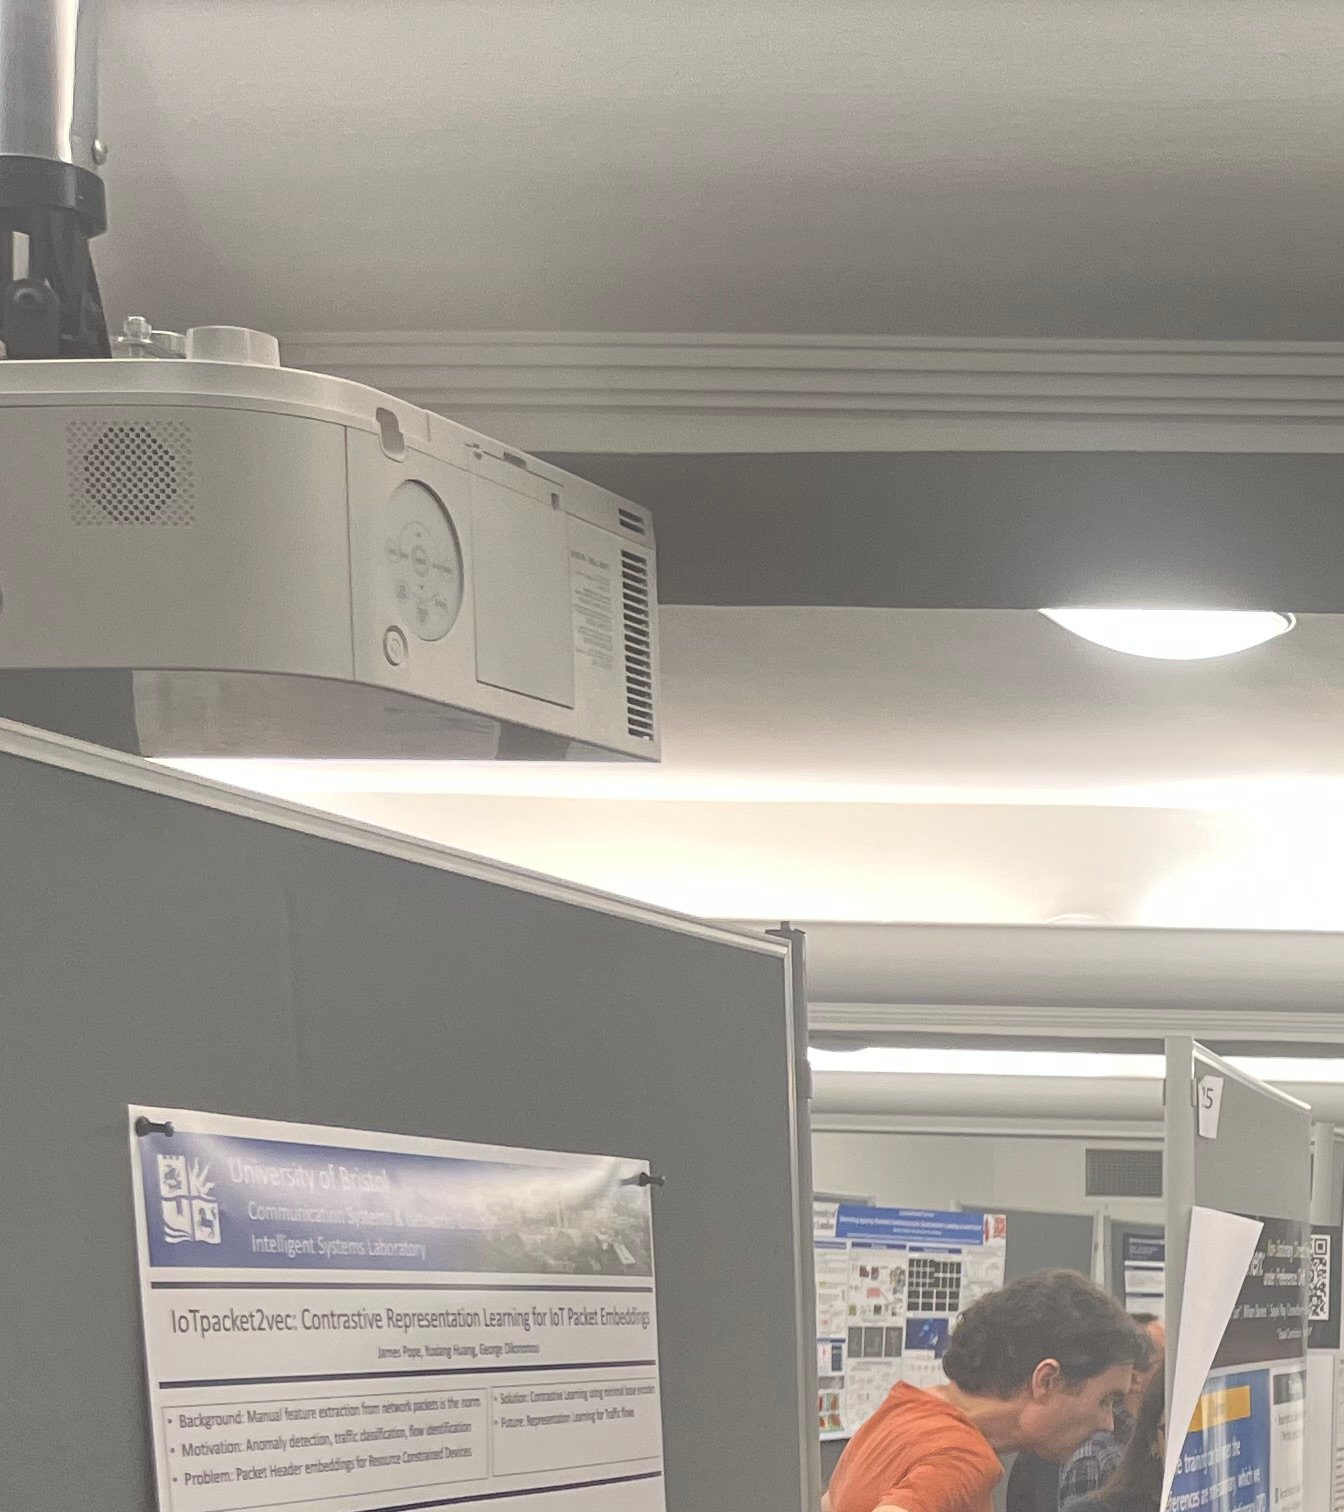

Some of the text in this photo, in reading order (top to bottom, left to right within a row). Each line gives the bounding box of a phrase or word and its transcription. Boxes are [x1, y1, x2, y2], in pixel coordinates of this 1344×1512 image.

[229, 1157, 389, 1193] University of Bristol
[248, 1200, 345, 1224] Communication
[251, 1233, 427, 1260] Intelligent Systems Laboratory
[171, 1306, 651, 1338] IoTpacket2vec: Contrastive Representation Learning for IoT Packet Embeddings
[179, 1410, 245, 1430] Background:
[246, 1407, 282, 1424] Manual
[285, 1406, 317, 1421] feature
[318, 1404, 360, 1419] extraction
[182, 1439, 243, 1457] Motivation:
[246, 1435, 287, 1453] Anomaly
[289, 1432, 333, 1448] detection,
[184, 1470, 235, 1486] Problem:
[236, 1465, 268, 1481] Packet
[270, 1461, 303, 1478] Header
[304, 1455, 356, 1474] embeddings
